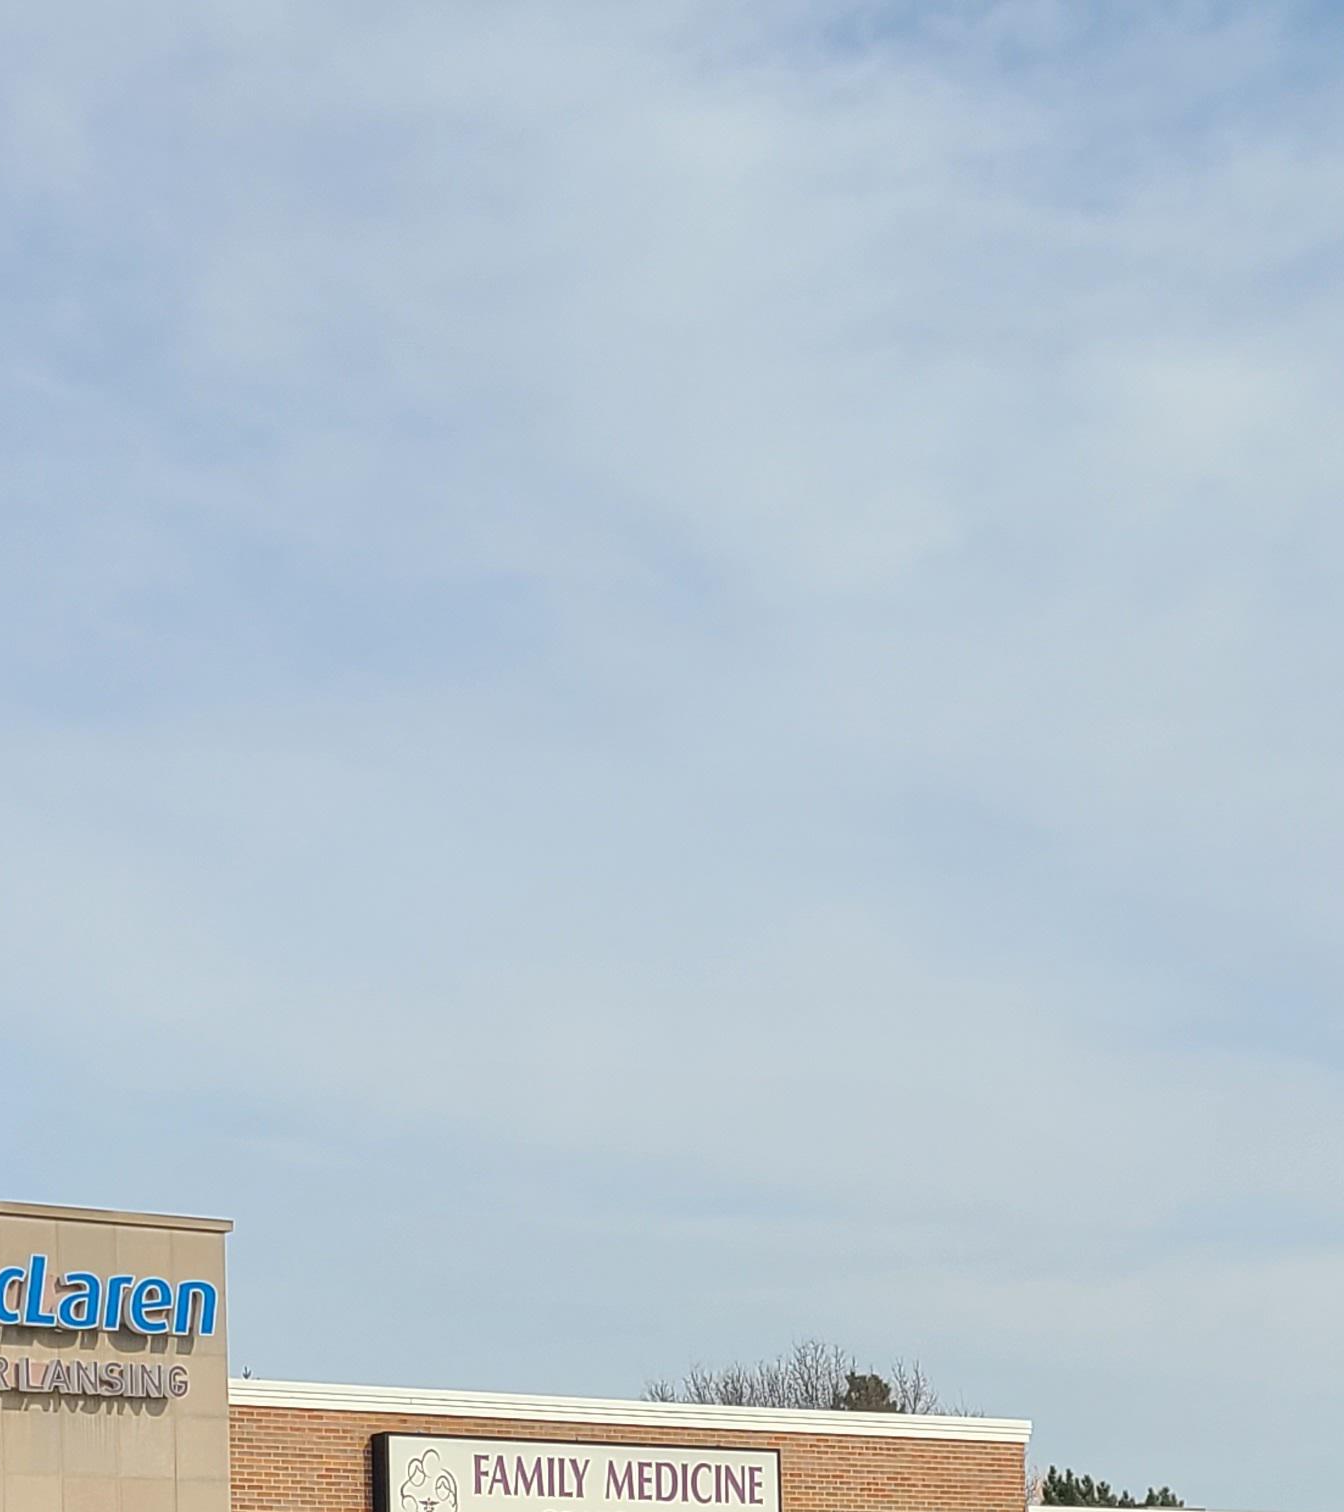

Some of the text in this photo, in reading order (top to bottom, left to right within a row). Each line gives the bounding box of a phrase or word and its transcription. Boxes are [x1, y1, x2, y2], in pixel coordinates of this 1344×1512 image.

[19, 1358, 189, 1398] LANSING
[473, 1454, 764, 1505] FAMILY MEDICINE
